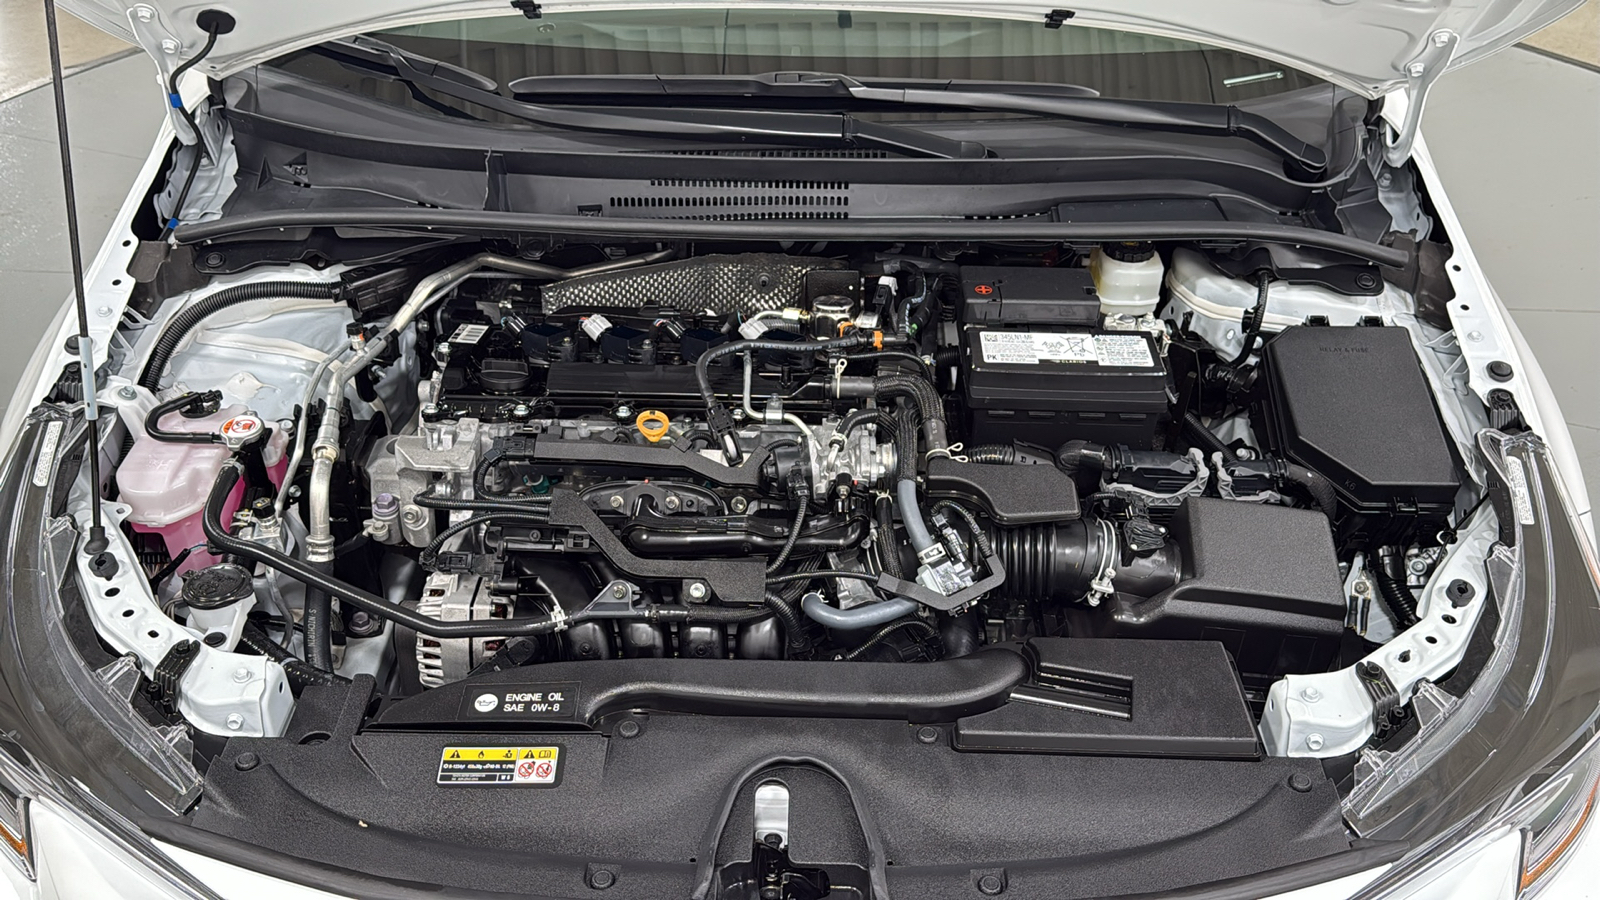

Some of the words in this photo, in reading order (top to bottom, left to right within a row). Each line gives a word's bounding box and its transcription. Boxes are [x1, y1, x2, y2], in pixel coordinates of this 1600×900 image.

[505, 693, 542, 702] ENGINE
[548, 692, 564, 701] OIL
[503, 704, 525, 712] SAE
[530, 703, 560, 712] 0W-8
